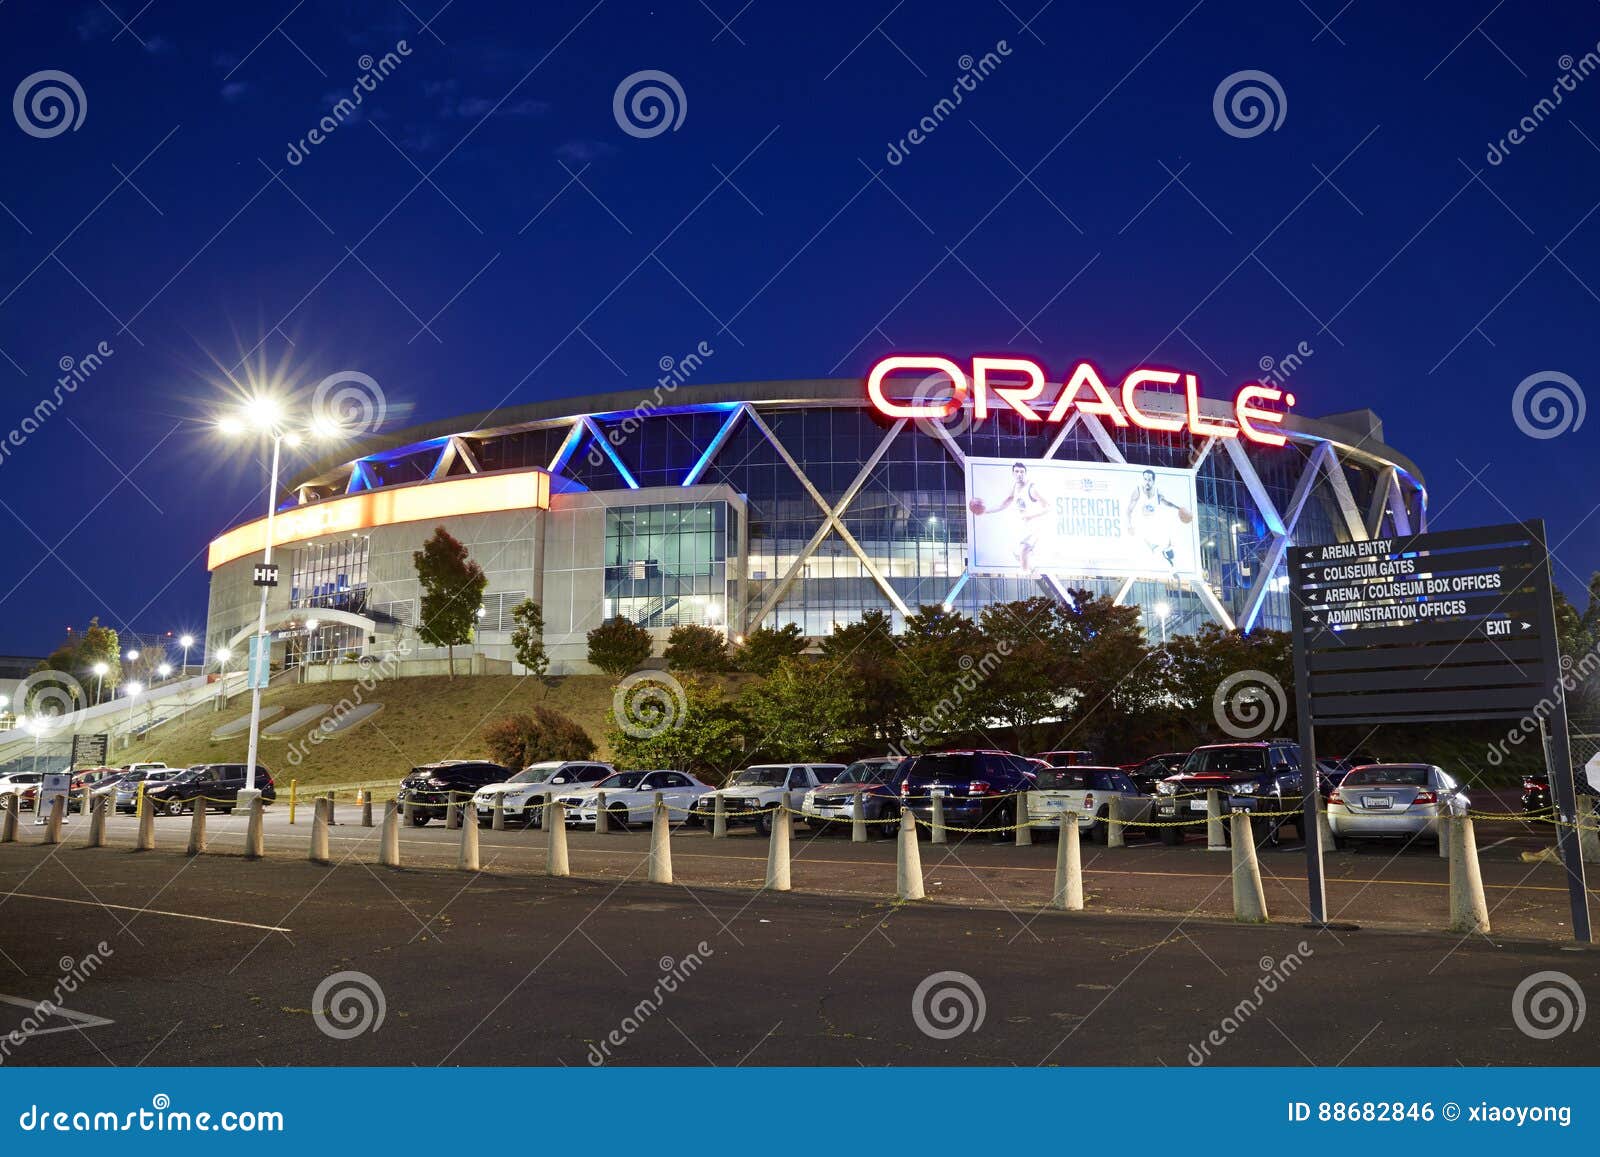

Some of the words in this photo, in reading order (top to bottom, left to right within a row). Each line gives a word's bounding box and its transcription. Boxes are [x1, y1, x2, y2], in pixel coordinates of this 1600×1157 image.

[867, 355, 1289, 447] ORACLE
[1056, 497, 1120, 517] STRENGTH
[1322, 543, 1357, 560] ARENA
[1358, 540, 1392, 556] ENTRY
[254, 568, 278, 581] HH
[1323, 563, 1377, 580] COLISEUM
[1379, 559, 1415, 575] GATES
[1325, 587, 1360, 602] ARENA
[1368, 581, 1424, 599] COLISEUM
[1427, 578, 1451, 594] BOX
[1452, 573, 1501, 591] OFFICES
[1327, 604, 1417, 624] ADMINISTRATION
[1419, 600, 1467, 617] OFFICES
[1486, 620, 1512, 636] EXIT
